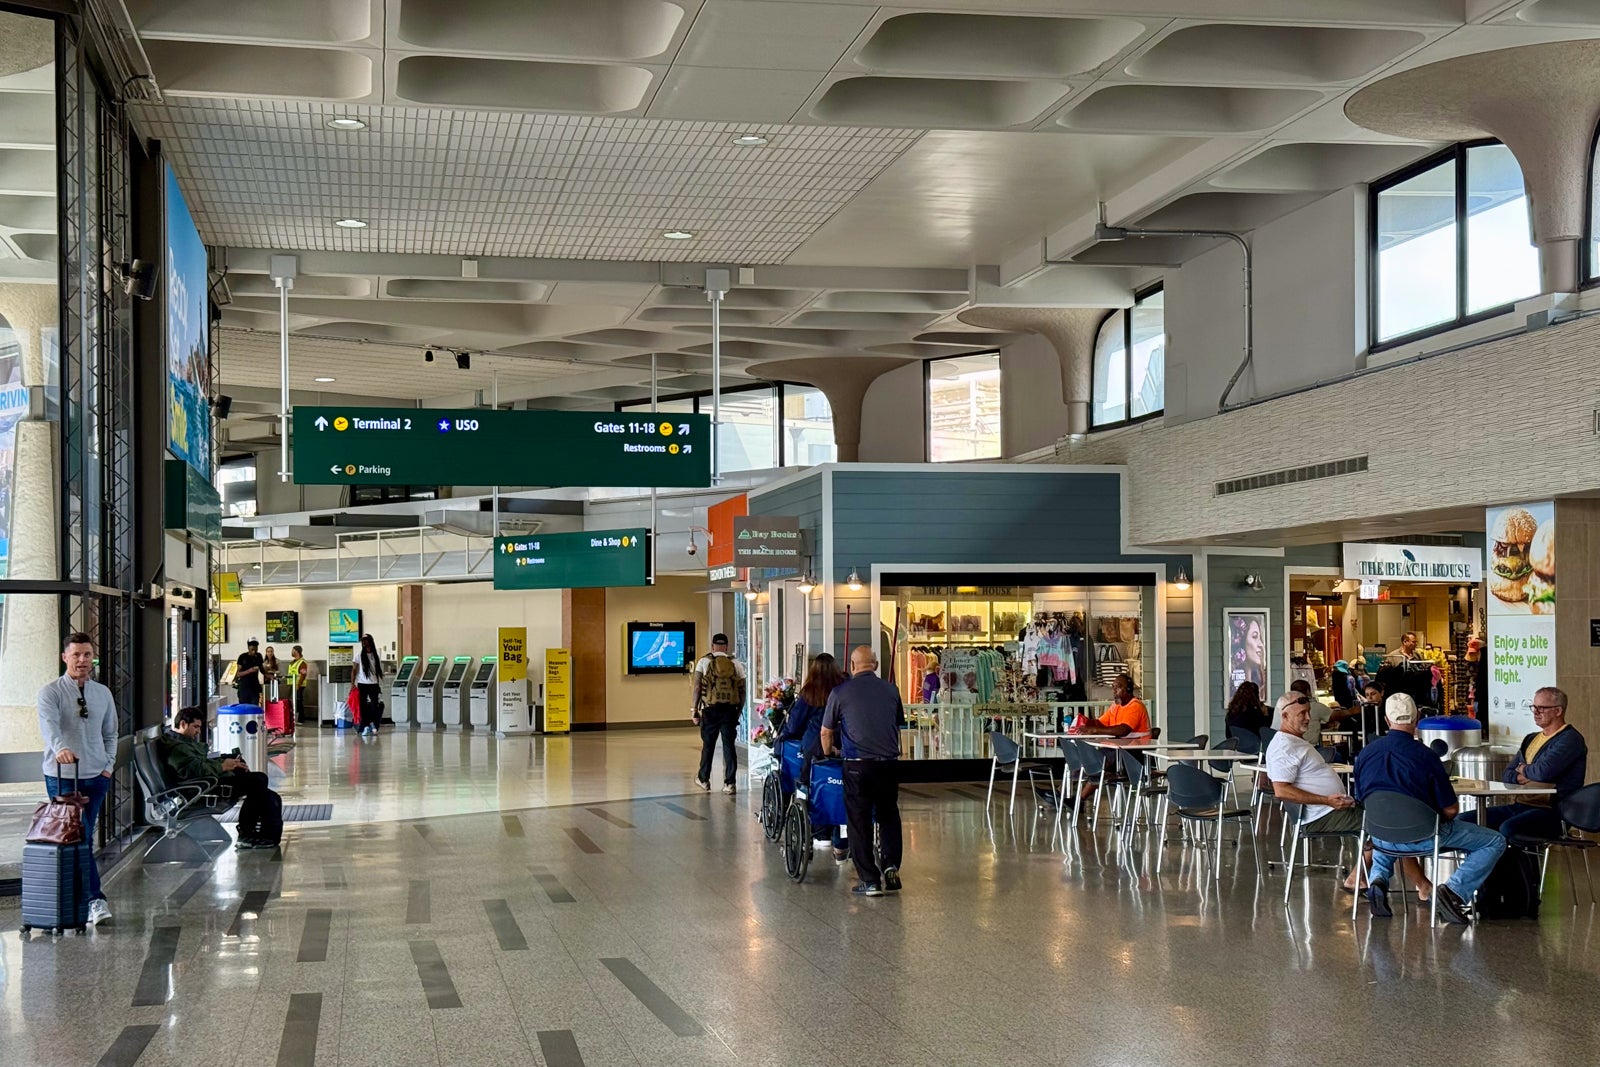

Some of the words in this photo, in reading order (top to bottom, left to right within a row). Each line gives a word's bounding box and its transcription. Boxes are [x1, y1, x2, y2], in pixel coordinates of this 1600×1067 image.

[352, 418, 400, 430] Terminal
[404, 418, 412, 430] 2
[455, 419, 479, 431] USO
[594, 422, 625, 434] Gates
[628, 422, 656, 434] 11-18
[624, 443, 666, 453] Restrooms
[358, 465, 391, 476] Parking
[608, 537, 621, 548] Shop
[1360, 561, 1384, 576] THE
[1386, 562, 1428, 577] BEACH
[1431, 564, 1471, 578] HOUSE
[1494, 635, 1519, 651] Enjoy
[1522, 638, 1528, 649] a
[1530, 634, 1548, 649] bite
[504, 652, 522, 663] Bag
[1494, 652, 1524, 666] before
[1526, 655, 1548, 668] your
[1494, 668, 1521, 685] flight.
